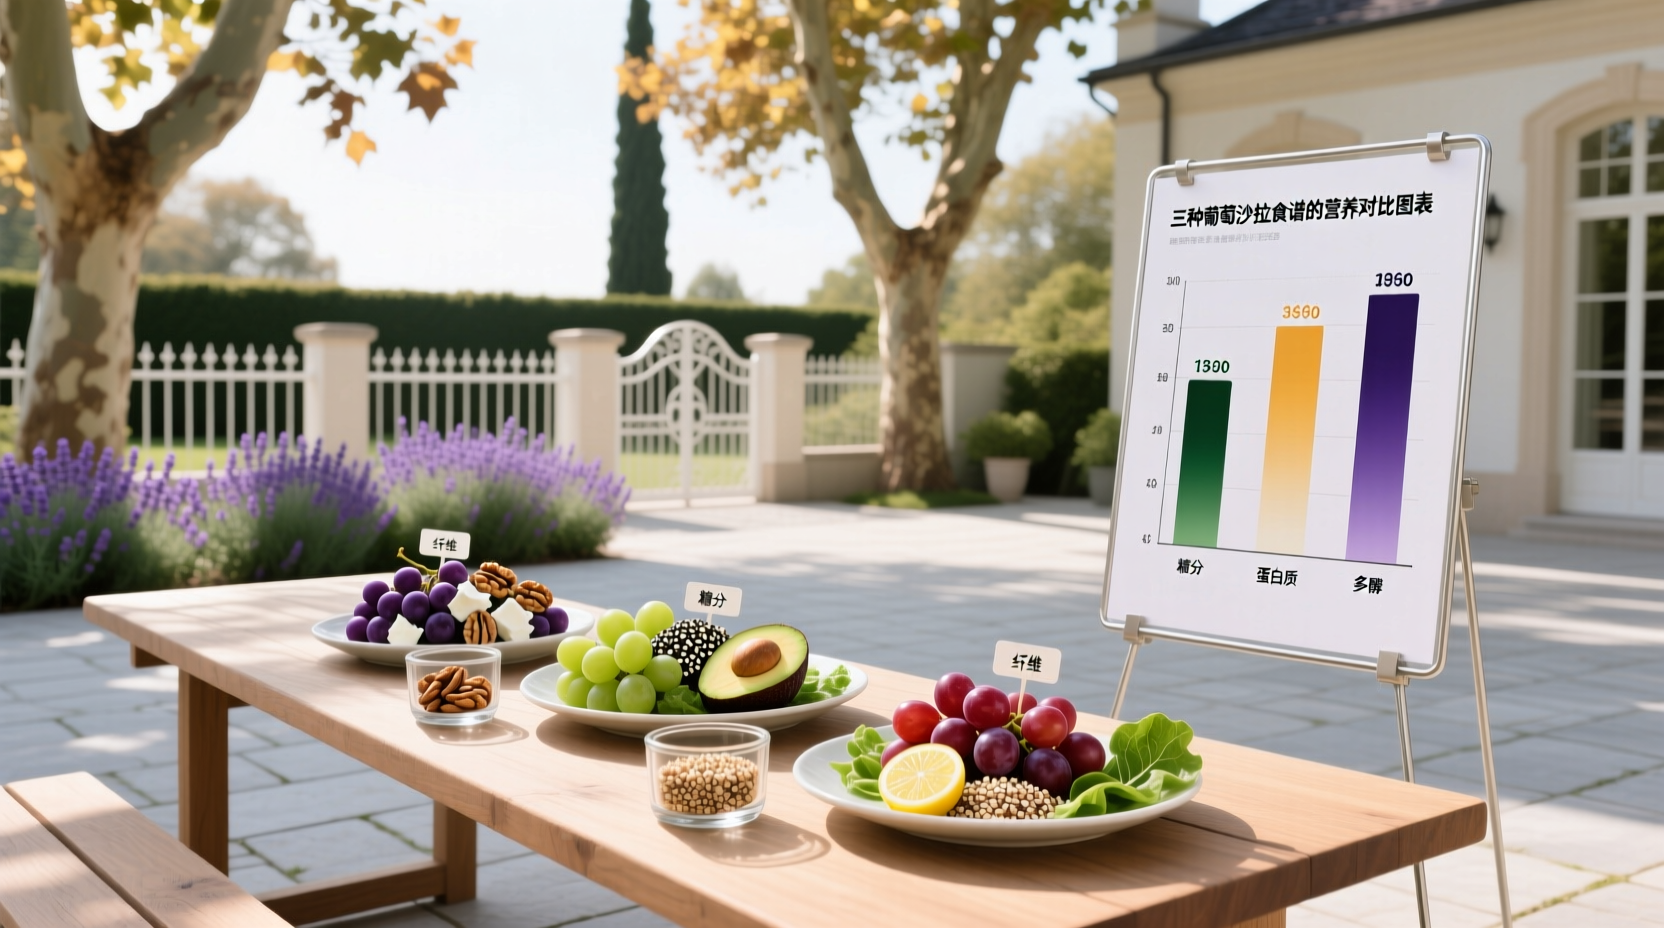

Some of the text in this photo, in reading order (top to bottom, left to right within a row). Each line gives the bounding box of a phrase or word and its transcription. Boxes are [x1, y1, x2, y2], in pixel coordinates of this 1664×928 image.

[1256, 566, 1299, 587] 蛋白质
[1011, 652, 1043, 673] 纤维
